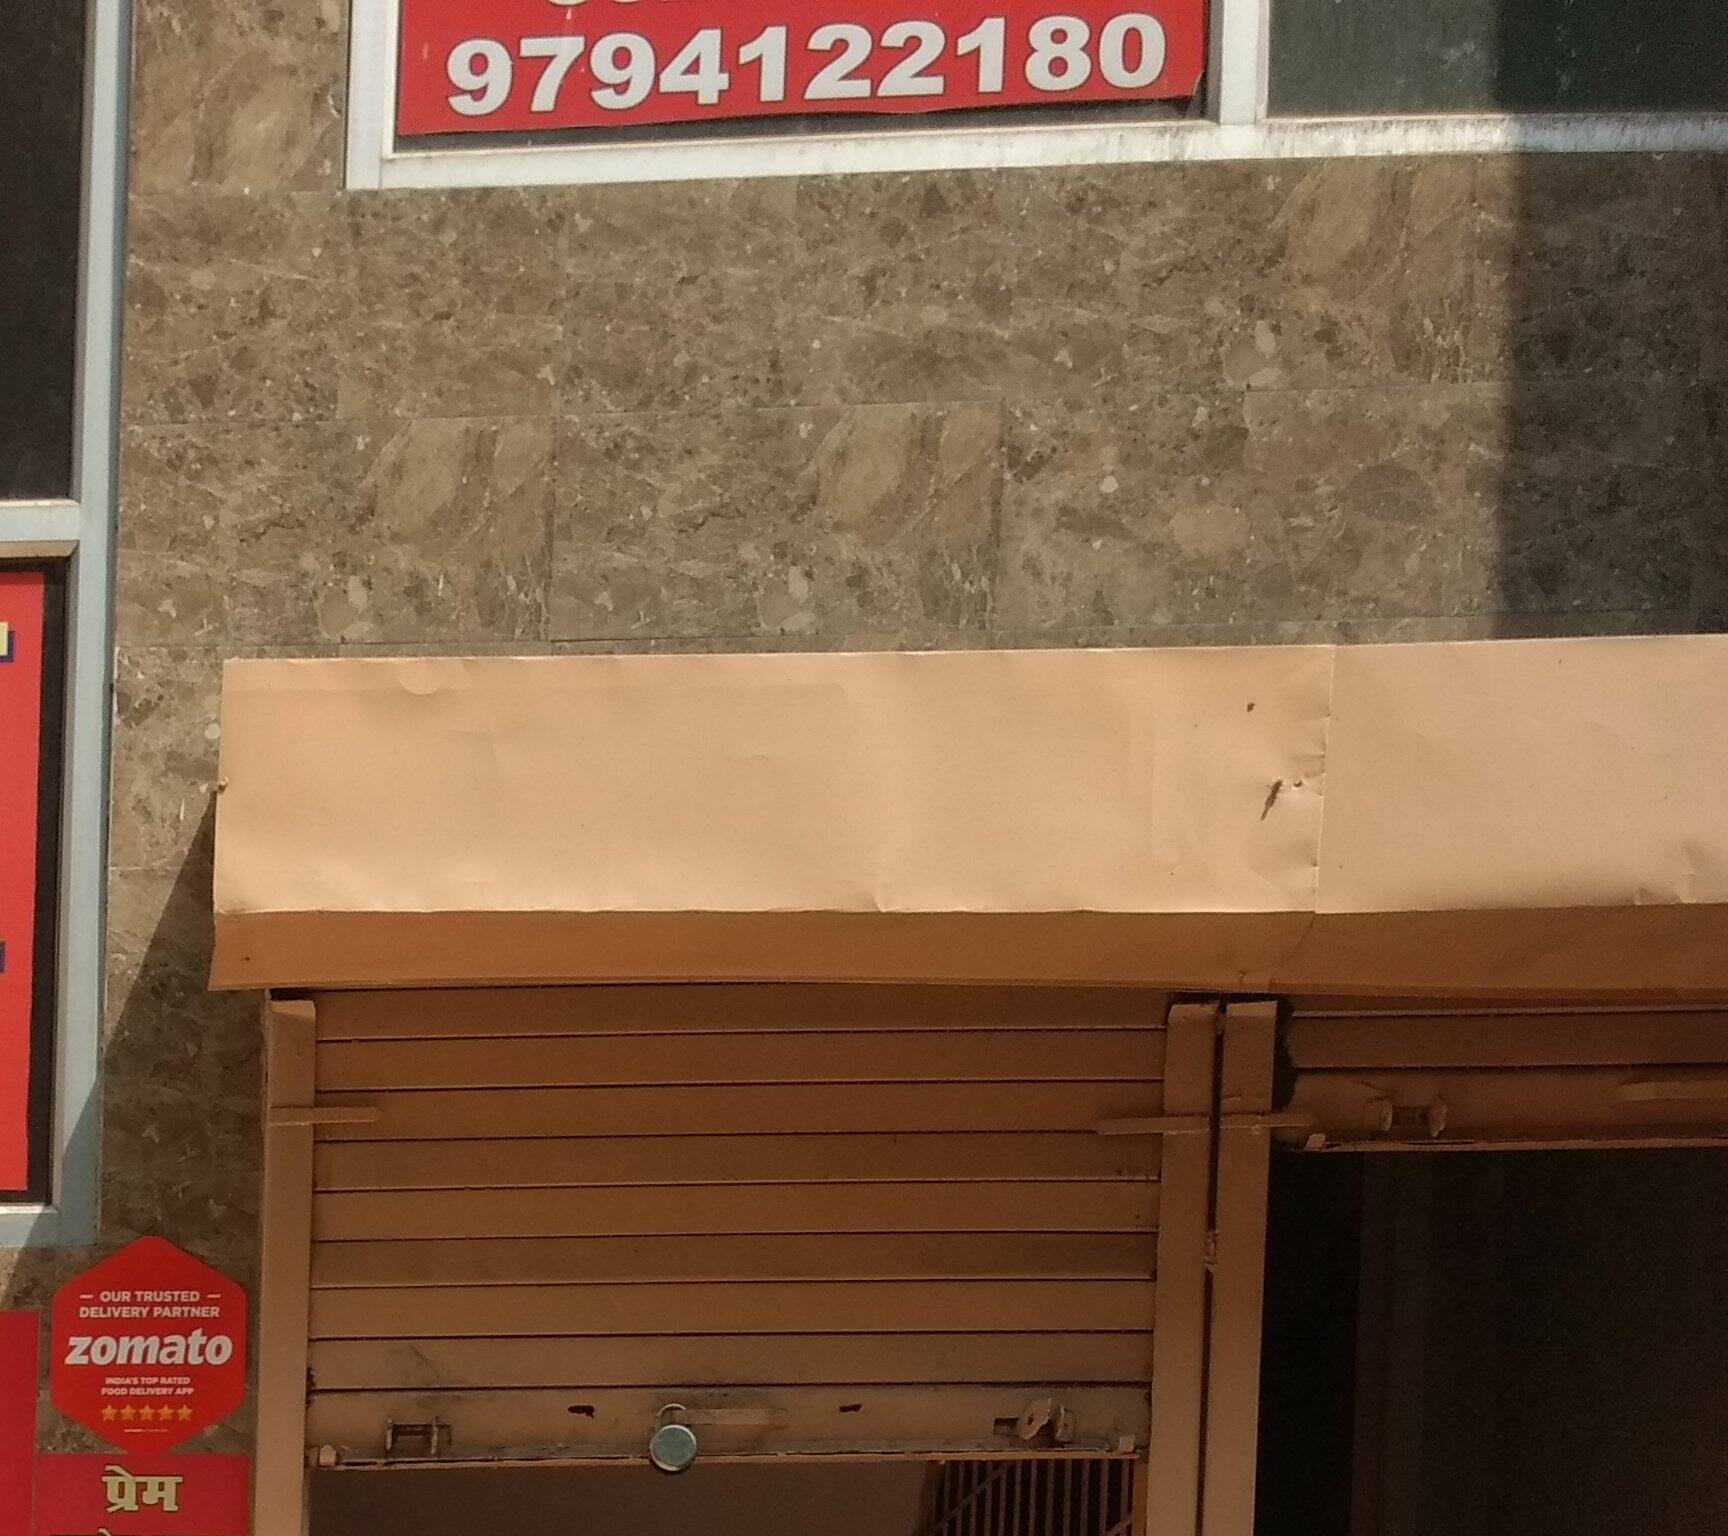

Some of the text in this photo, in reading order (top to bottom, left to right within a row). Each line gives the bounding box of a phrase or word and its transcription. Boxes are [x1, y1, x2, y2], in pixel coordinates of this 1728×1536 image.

[446, 12, 1168, 118] 9794122180
[100, 1290, 200, 1303] OUR TRUSTED
[79, 1306, 220, 1318] DELIVERY PARTNER
[64, 1328, 233, 1366] zomato
[140, 1376, 159, 1386] TOP
[160, 1376, 191, 1386] RATED
[129, 1387, 174, 1396] DELIVERY
[175, 1387, 195, 1396] APP
[101, 1465, 183, 1514] प्रेम
